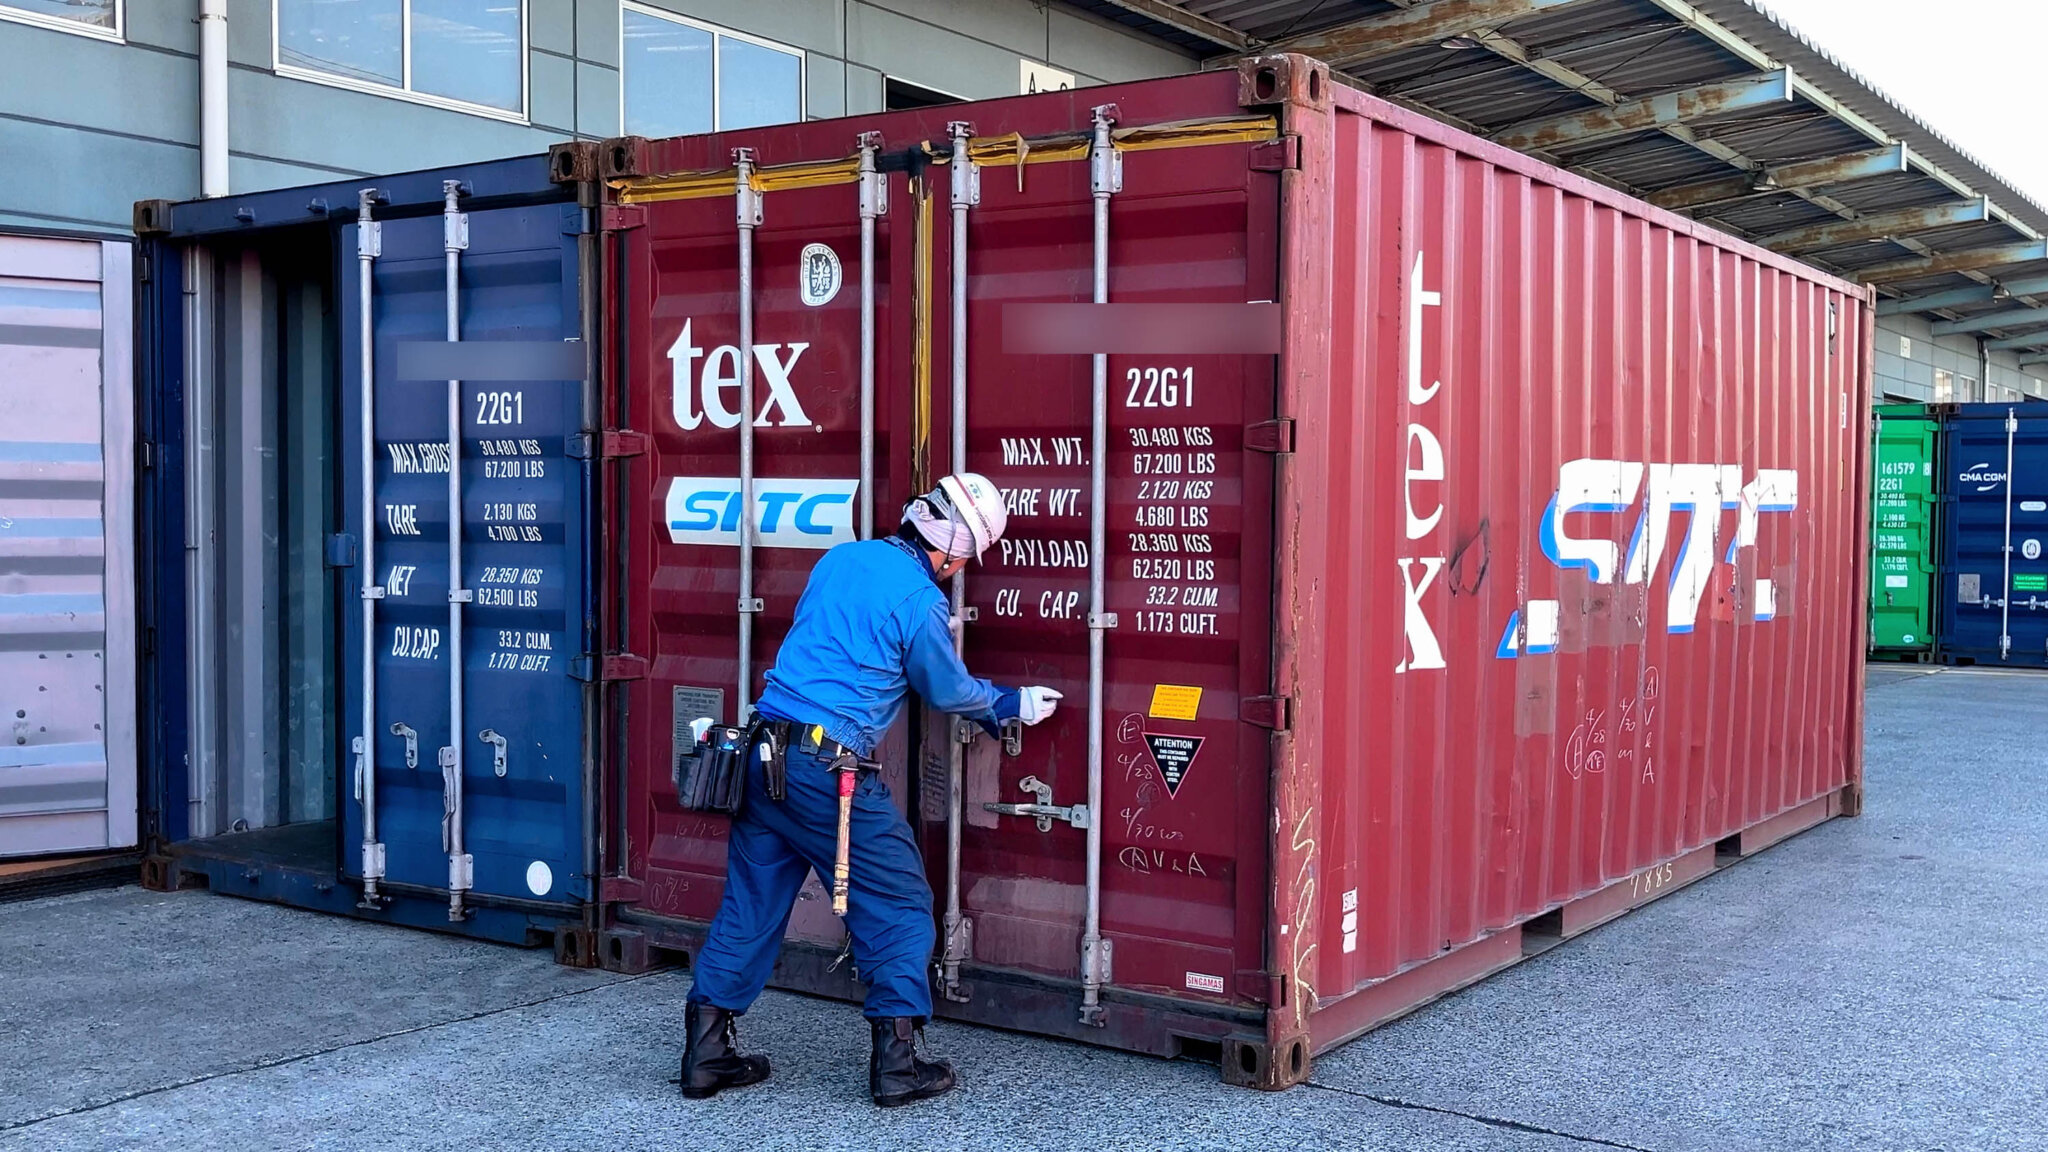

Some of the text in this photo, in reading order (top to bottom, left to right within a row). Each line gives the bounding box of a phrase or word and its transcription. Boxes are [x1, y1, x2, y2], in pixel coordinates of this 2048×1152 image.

[667, 317, 812, 431] tex
[1126, 367, 1193, 407] 22G1
[476, 391, 523, 425] 22G1
[1183, 427, 1213, 446] KGS
[521, 439, 541, 456] KGS
[1001, 437, 1090, 466] MAX. WT.
[525, 460, 544, 478] LBS
[1188, 453, 1215, 474] LBS
[1882, 462, 1931, 476] 161579 8
[1880, 478, 1902, 491] 22G1
[1960, 473, 2006, 482] CMA CGM
[1183, 480, 1213, 499] KGS
[517, 503, 537, 521] KGS
[1000, 488, 1082, 517] TARE WT.
[385, 504, 421, 535] TARE
[671, 491, 852, 535] SITC
[1181, 506, 1208, 527] LBS
[519, 526, 542, 542] LBS
[1182, 534, 1212, 553] KGS
[1001, 538, 1089, 568] PAYLOAD
[520, 568, 543, 585] KGS
[1187, 560, 1214, 580] LBS
[387, 566, 417, 596] NET
[518, 590, 538, 607] LBS
[995, 589, 1081, 620] CU. CAP.
[1146, 586, 1218, 607] 33.2 CU.M.
[499, 630, 521, 649] 33.2
[1154, 738, 1193, 749] ATTENTION
[1630, 863, 1672, 898] 7885
[1187, 975, 1222, 989] SINGAMAS
